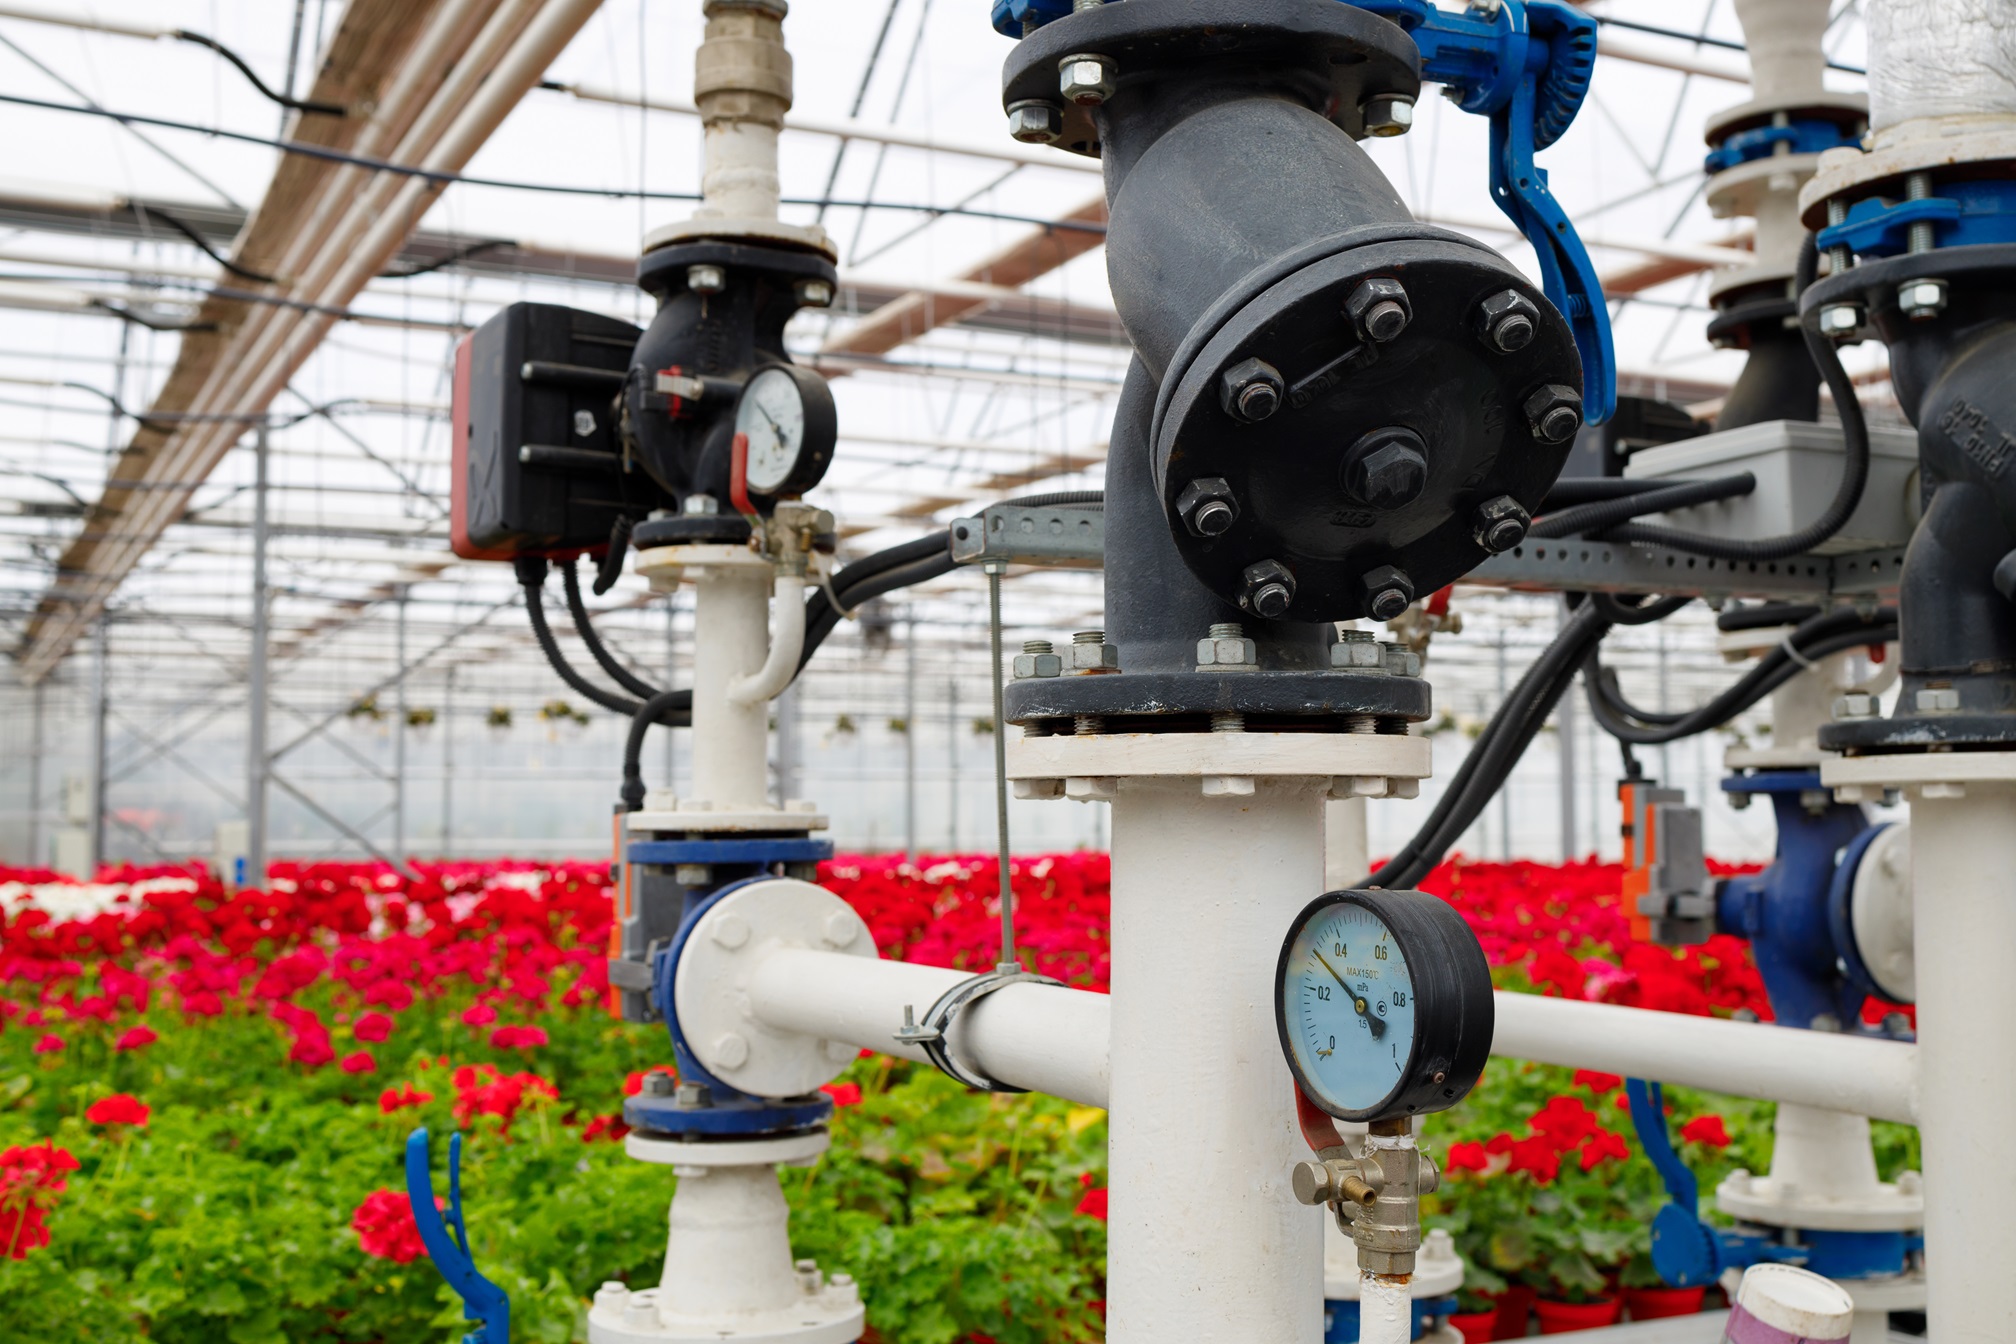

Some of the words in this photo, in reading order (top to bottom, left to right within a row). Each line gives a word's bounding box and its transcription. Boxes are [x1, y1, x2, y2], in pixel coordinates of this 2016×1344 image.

[1334, 942, 1347, 958] 0.4
[1374, 945, 1388, 961] 0.6
[1318, 985, 1331, 1001] 0.2
[1357, 982, 1369, 992] mPa
[1393, 991, 1406, 1008] 0.8
[1358, 1019, 1367, 1029] 1.5
[1329, 1035, 1336, 1050] 0
[1391, 1043, 1396, 1058] 1
